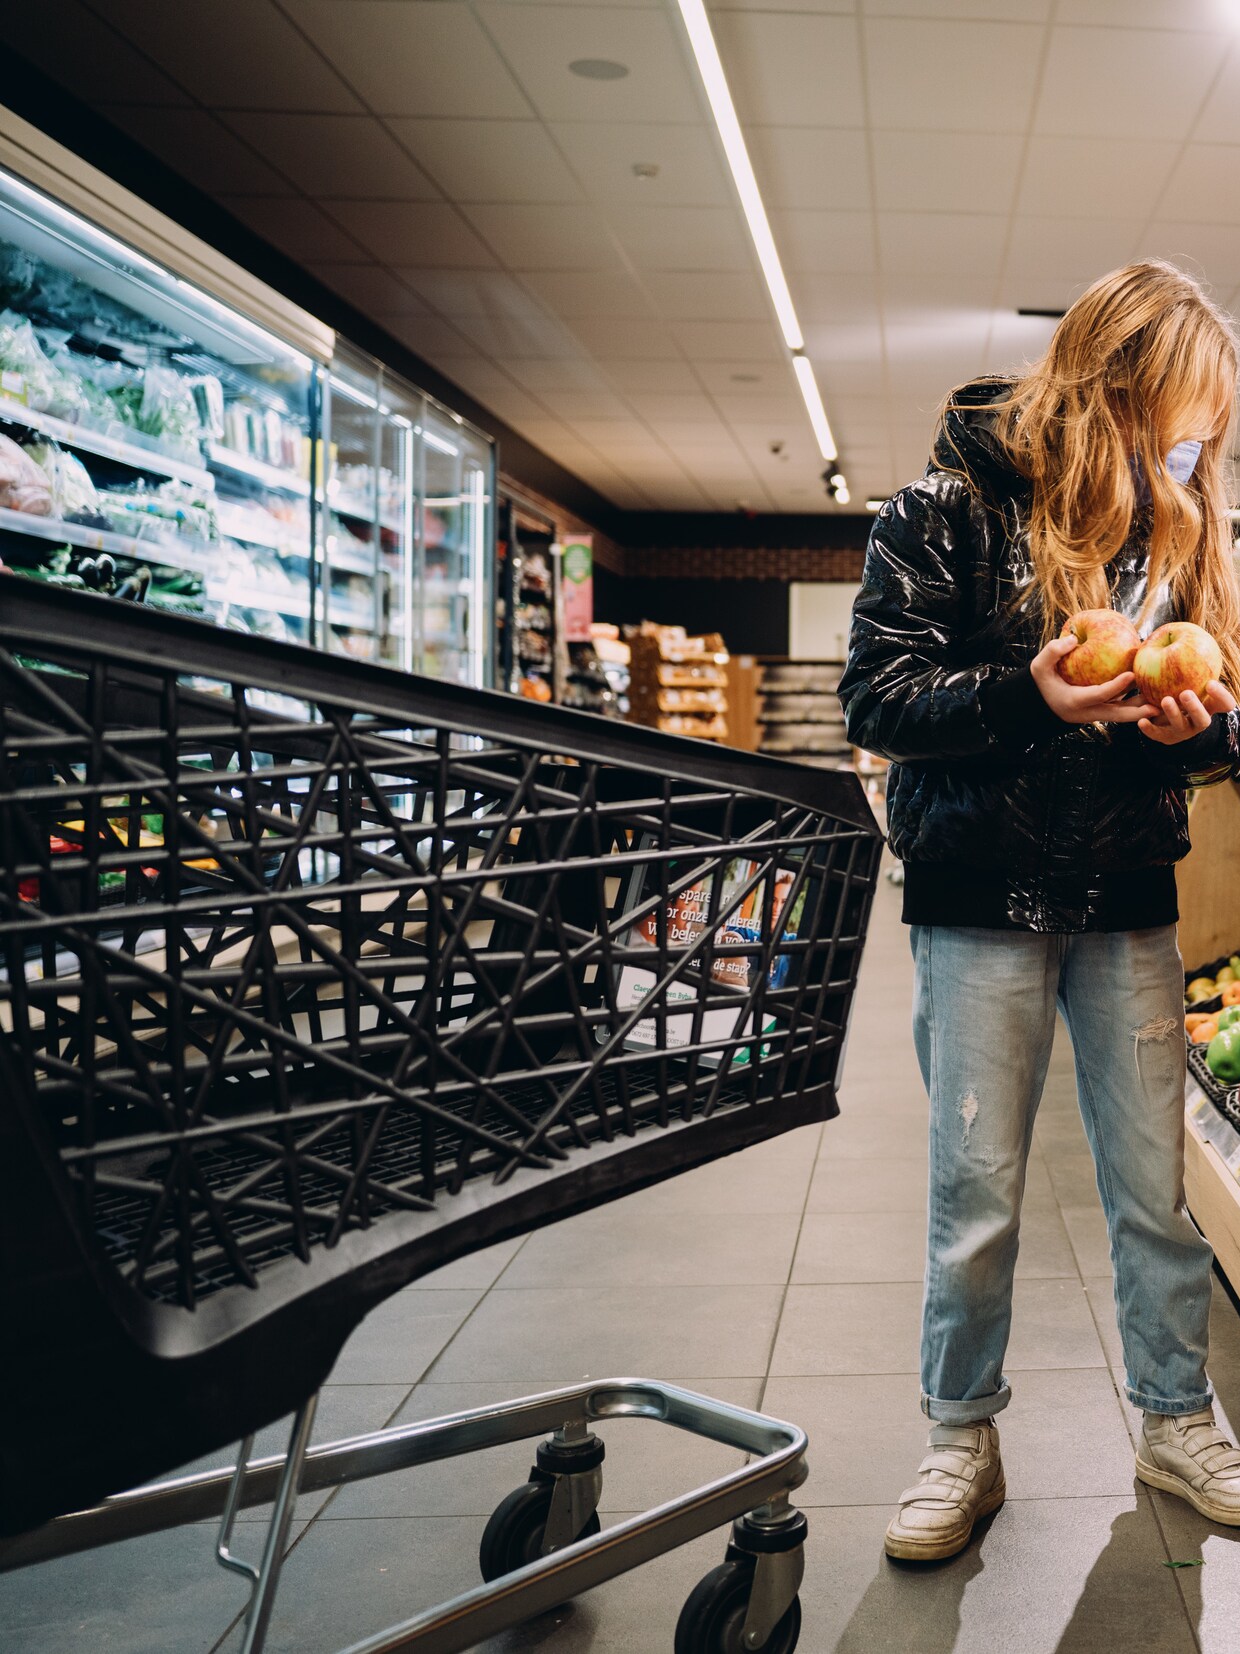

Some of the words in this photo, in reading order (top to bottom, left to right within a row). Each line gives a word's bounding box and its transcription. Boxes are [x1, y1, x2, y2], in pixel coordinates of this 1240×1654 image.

[680, 909, 708, 923] onze
[713, 959, 725, 971] de
[726, 962, 751, 977] stap?
